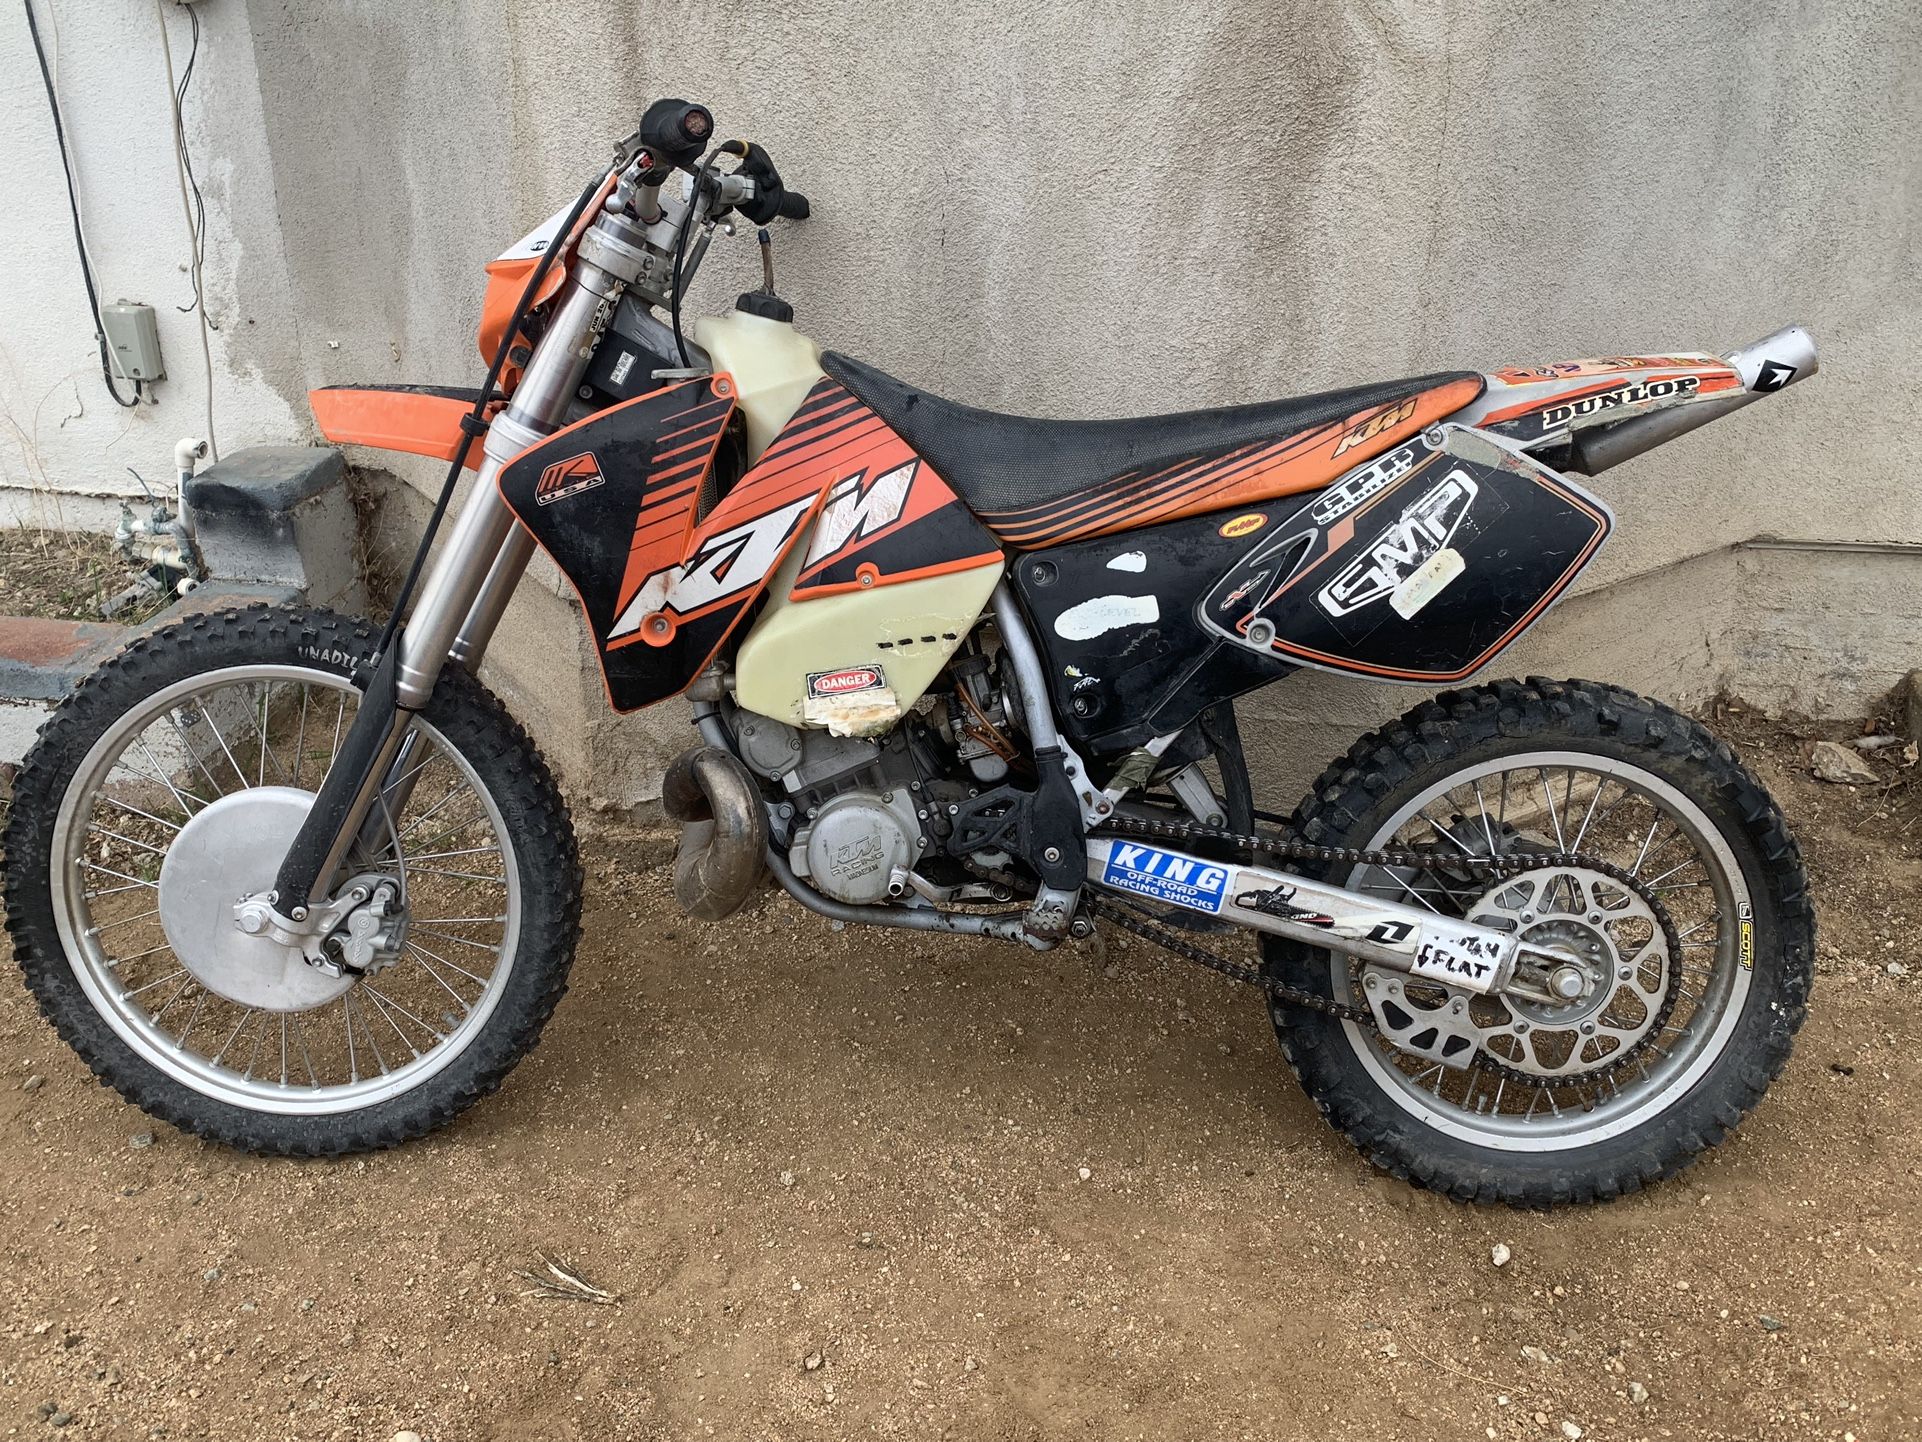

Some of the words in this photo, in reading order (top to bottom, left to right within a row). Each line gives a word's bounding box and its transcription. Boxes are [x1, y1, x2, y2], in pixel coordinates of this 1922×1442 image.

[1543, 377, 1700, 430] DUNLOP
[1331, 398, 1418, 460] KTM
[540, 479, 600, 501] USA
[1313, 449, 1411, 518] GPR
[606, 460, 920, 639] KTM
[821, 672, 871, 690] DANGER
[830, 851, 885, 877] RACING
[1113, 844, 1226, 892] KING
[1126, 871, 1198, 896] OFF-ROAD
[1109, 875, 1160, 896] RACING
[1163, 890, 1215, 910] SHOCKS
[1431, 949, 1492, 979] FLAT
[1740, 921, 1753, 969] SCOTT
